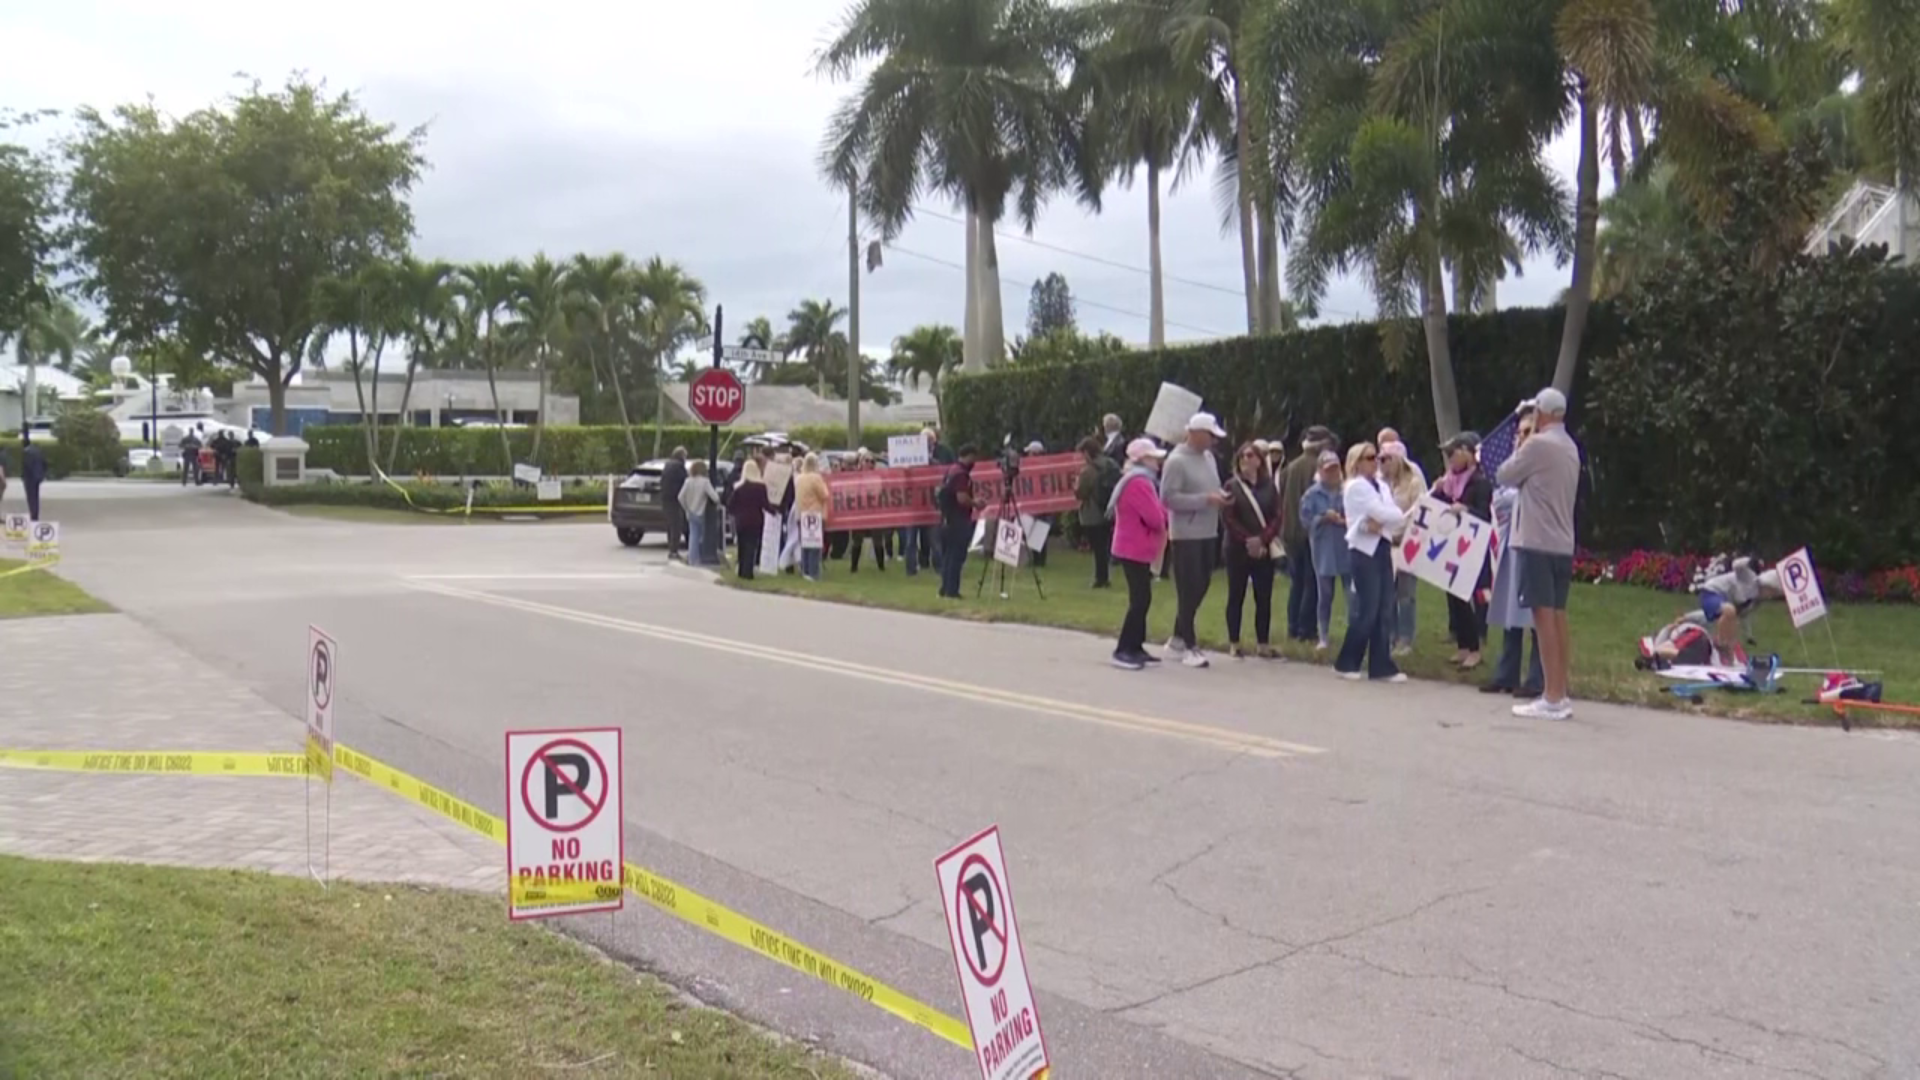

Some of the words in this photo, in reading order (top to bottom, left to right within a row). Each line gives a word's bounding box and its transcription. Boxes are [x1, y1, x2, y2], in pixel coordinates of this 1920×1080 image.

[751, 350, 767, 360] Ave
[694, 384, 740, 408] STOP
[832, 485, 913, 512] RELEASE
[1041, 470, 1079, 496] FILE
[551, 837, 581, 861] NO
[519, 859, 614, 888] PARKING
[989, 987, 1008, 1026] NO
[982, 1006, 1033, 1078] PARKING
